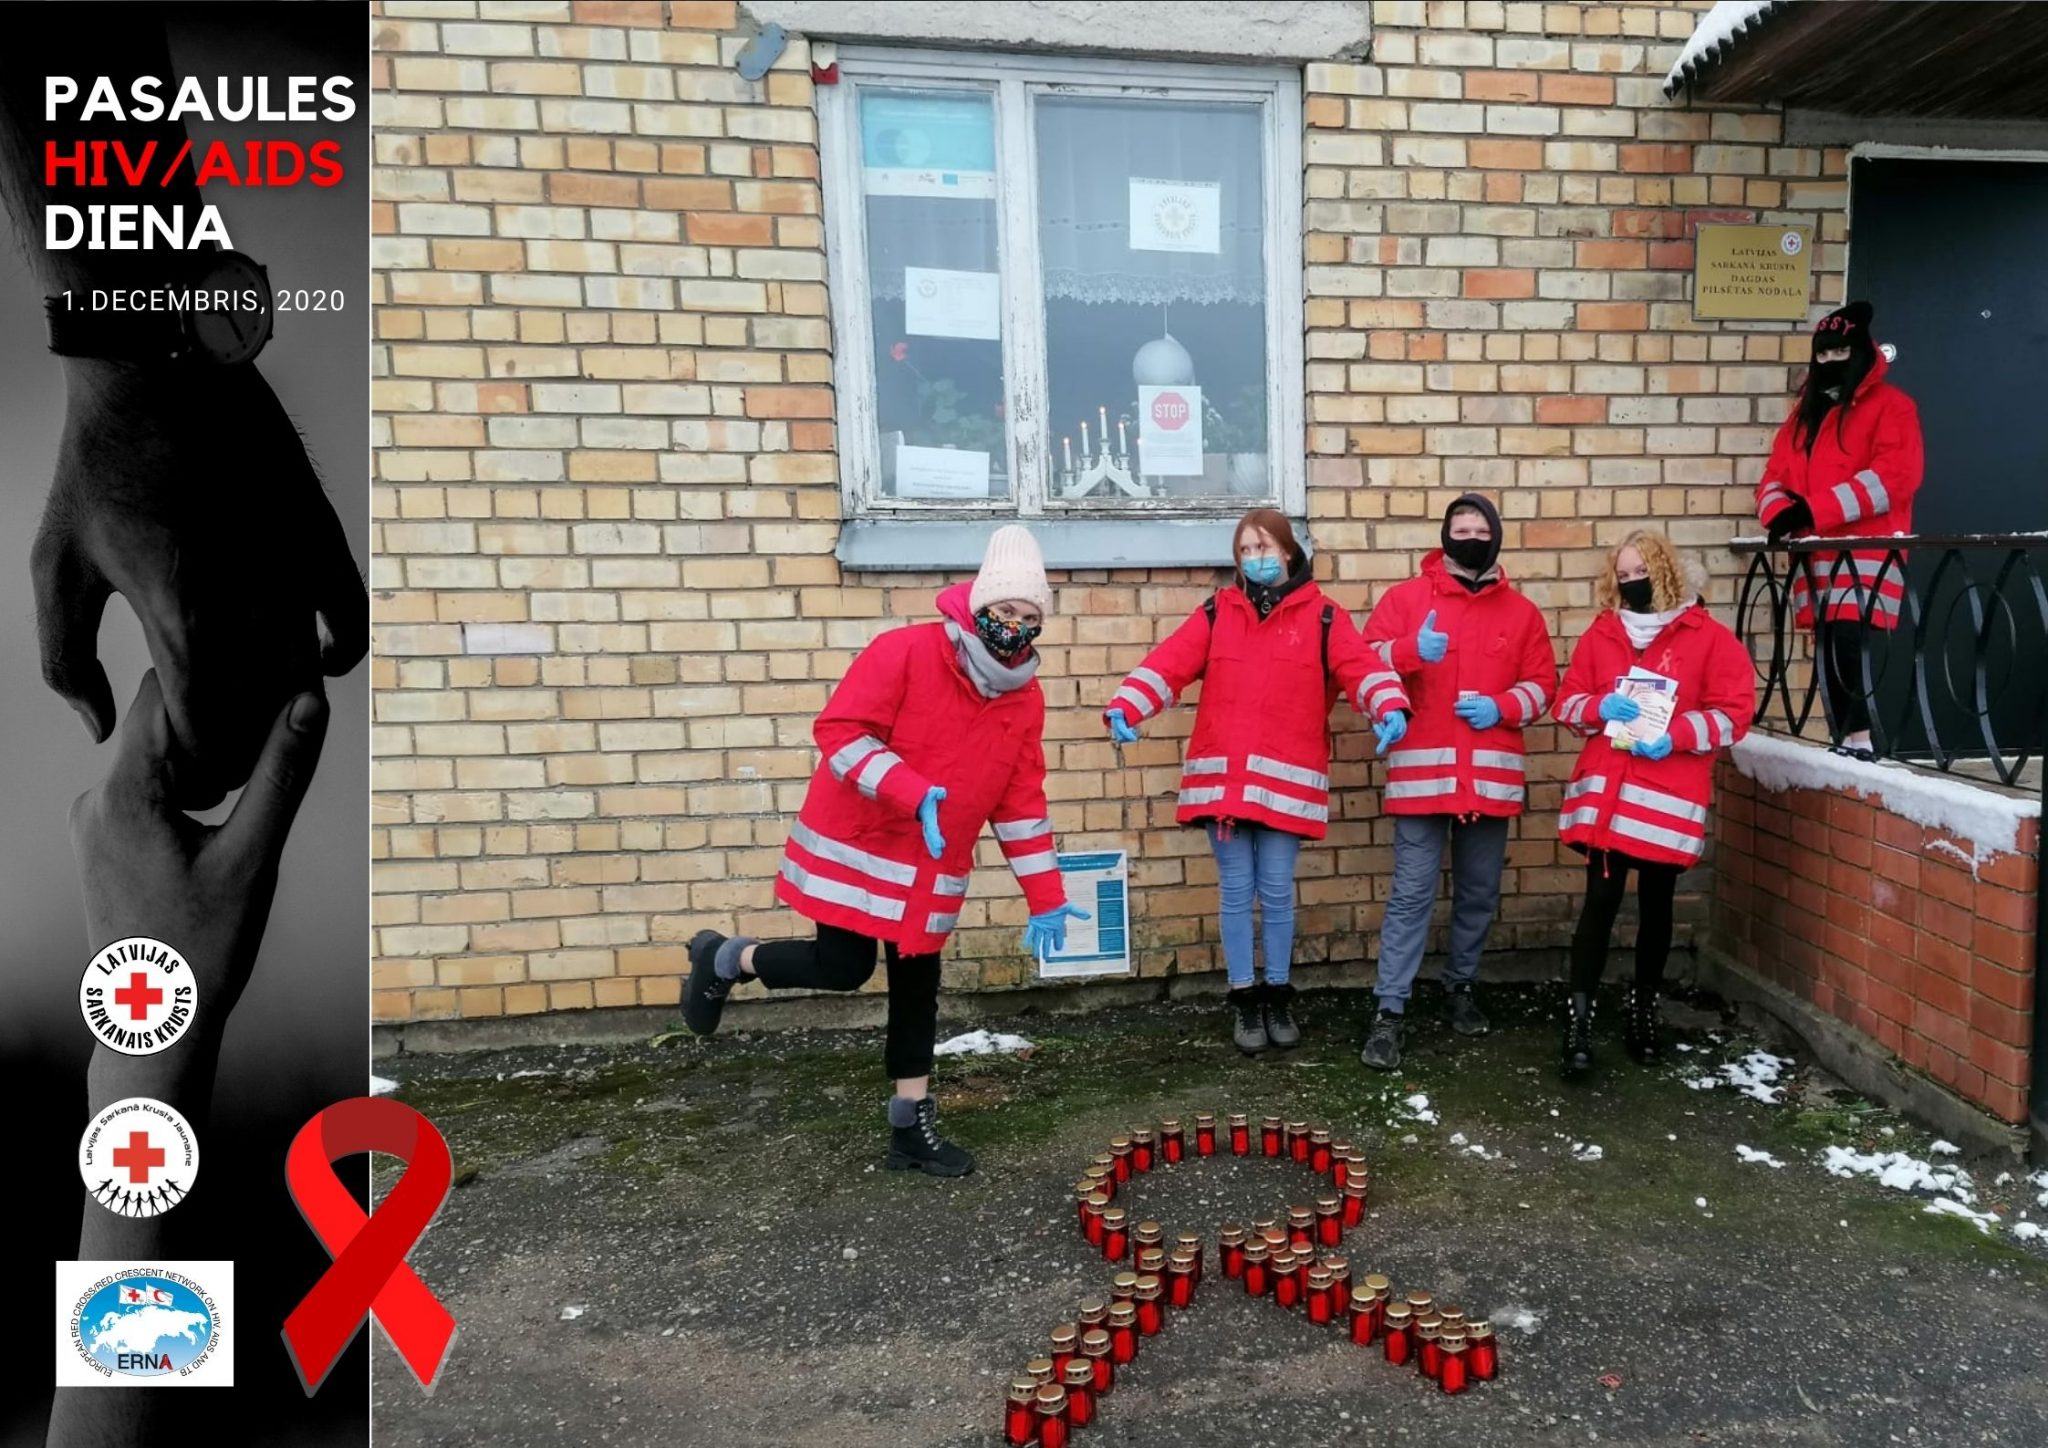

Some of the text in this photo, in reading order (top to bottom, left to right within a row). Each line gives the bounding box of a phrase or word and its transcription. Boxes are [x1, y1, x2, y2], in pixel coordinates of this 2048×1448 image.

[1731, 248, 1777, 257] LATVIJAS
[1759, 263, 1796, 271] KRUSTA
[1731, 274, 1776, 284] DAGDAS
[1154, 403, 1187, 419] STOP
